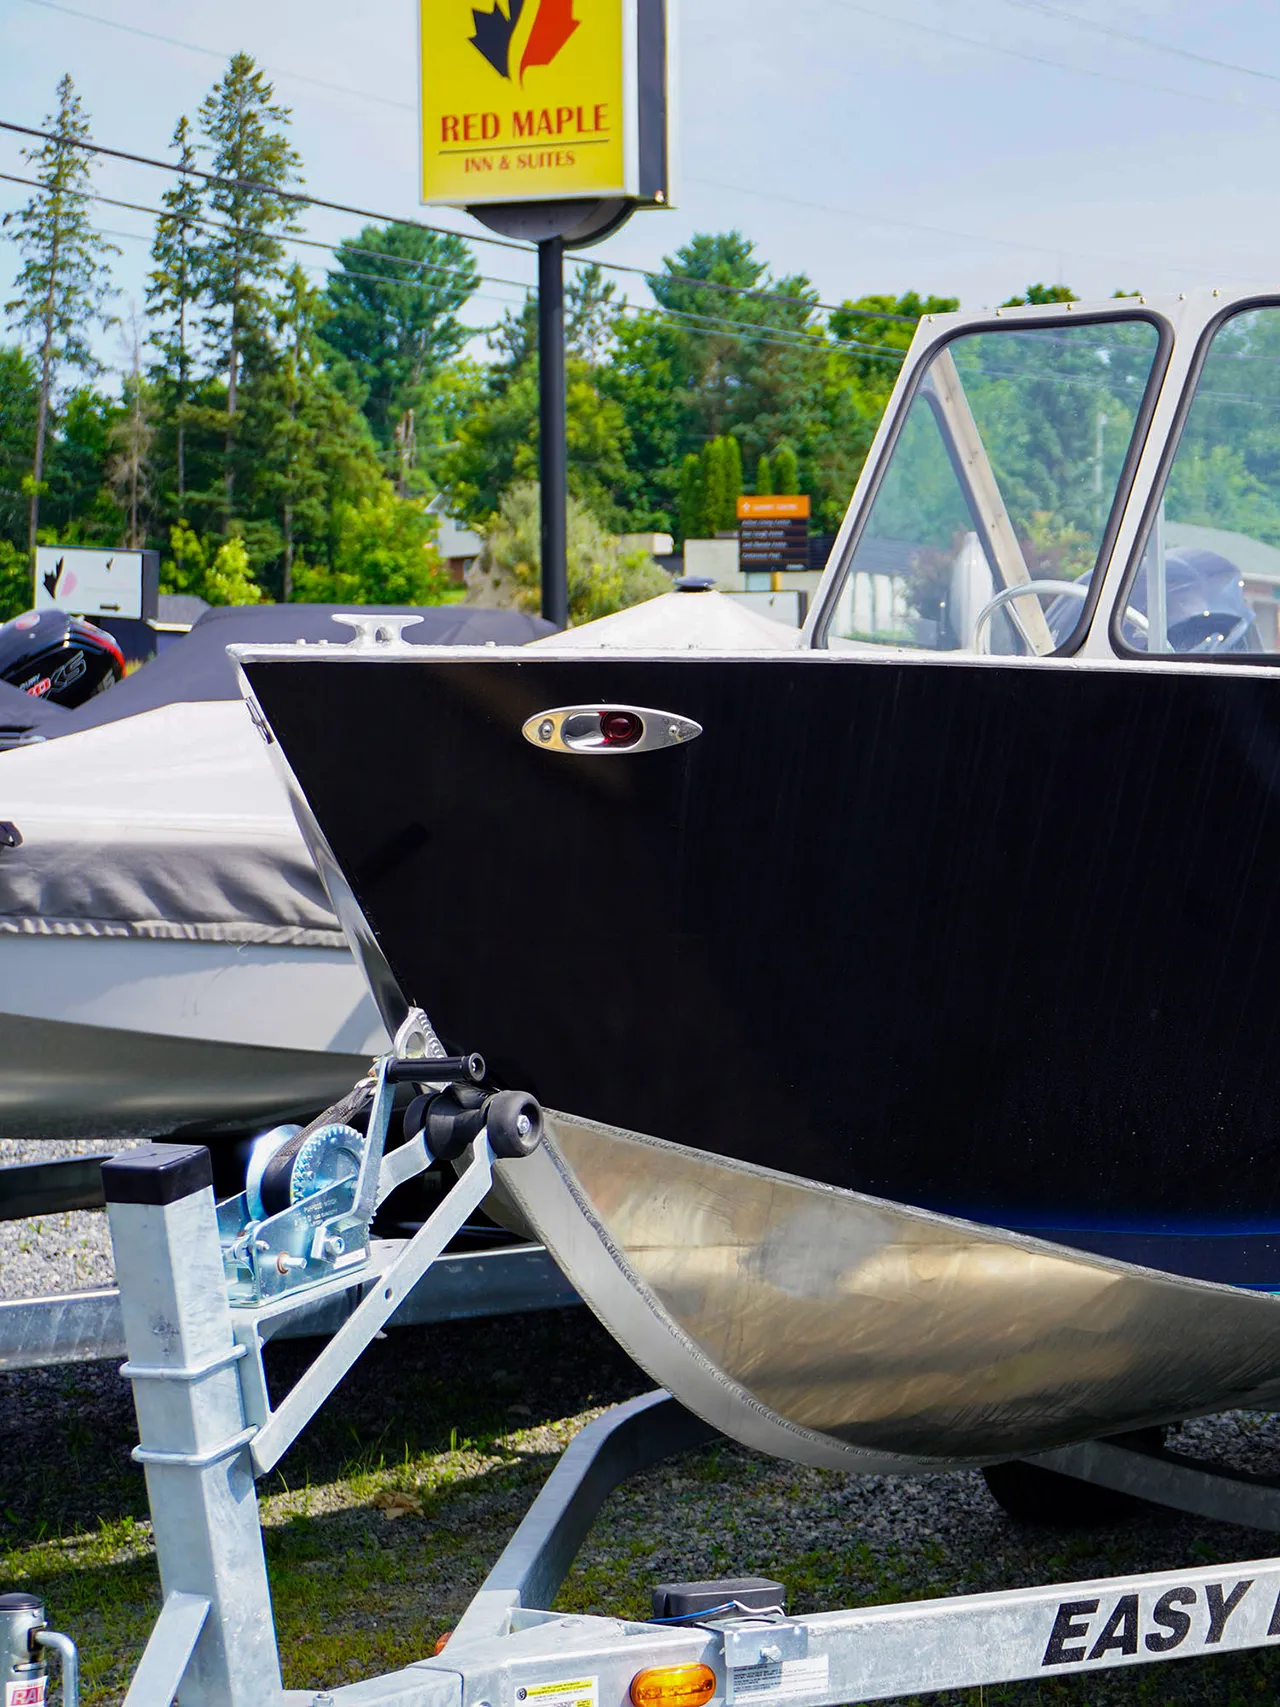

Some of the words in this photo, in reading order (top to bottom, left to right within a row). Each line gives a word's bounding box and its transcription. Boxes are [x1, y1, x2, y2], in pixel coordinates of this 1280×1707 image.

[441, 112, 500, 143] RED
[512, 103, 611, 138] MAPLE
[464, 157, 493, 174] INN
[499, 155, 510, 171] &
[516, 151, 576, 170] SUITES
[1041, 1579, 1255, 1667] EASY
